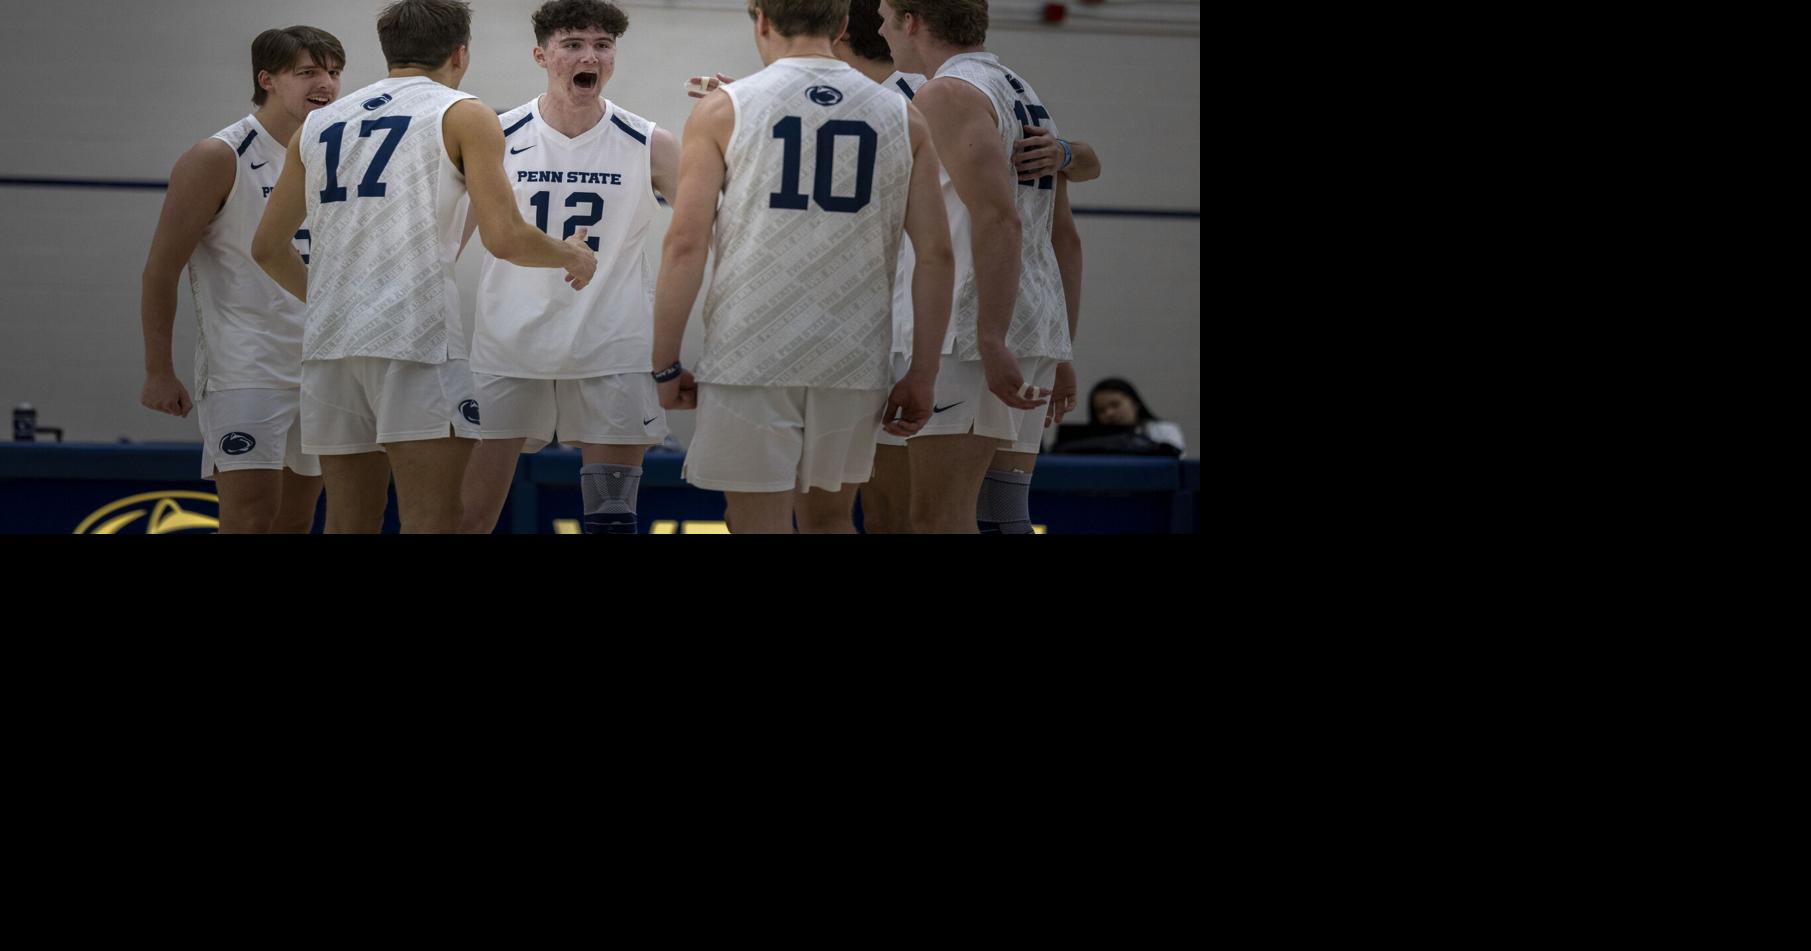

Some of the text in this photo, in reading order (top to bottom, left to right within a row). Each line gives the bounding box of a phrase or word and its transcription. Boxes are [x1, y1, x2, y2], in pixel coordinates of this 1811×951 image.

[319, 116, 412, 204] 17
[517, 170, 622, 186] PENN STATE
[769, 116, 877, 213] 10
[530, 190, 604, 252] 12
